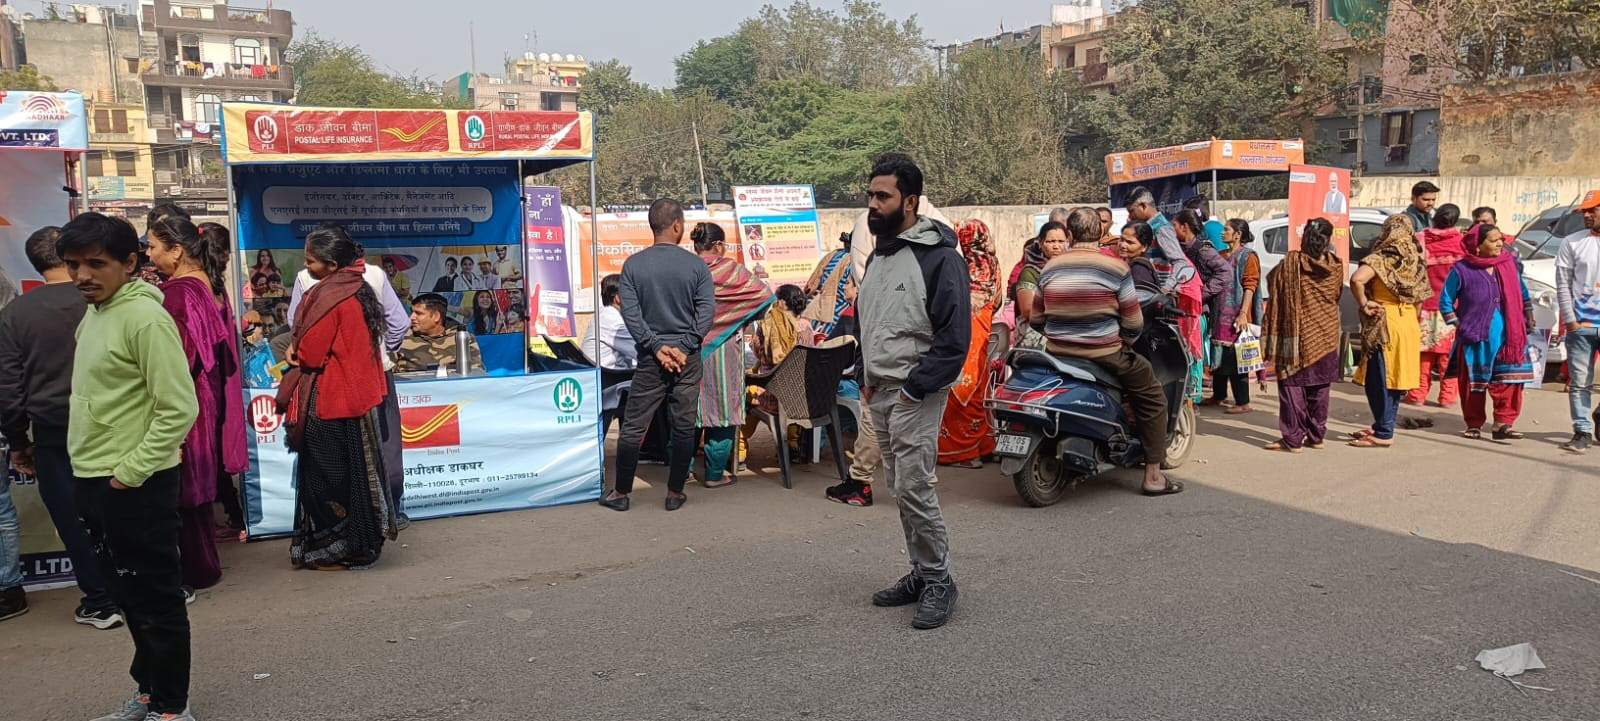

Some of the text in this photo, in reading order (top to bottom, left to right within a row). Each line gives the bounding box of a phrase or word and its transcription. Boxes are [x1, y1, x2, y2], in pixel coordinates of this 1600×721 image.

[293, 120, 372, 133] डाक जीवन बीमा
[294, 135, 373, 144] POSTAL LIFE INSURANCE
[432, 163, 453, 176] लिए
[457, 163, 470, 175] भी
[438, 191, 456, 201] आदि
[472, 203, 487, 214] लिए
[348, 221, 373, 232] जीवन
[376, 220, 395, 232] बीमा
[399, 221, 410, 232] का
[413, 394, 433, 405] डाक
[557, 414, 582, 424] RPLI
[257, 435, 276, 444] PLI
[446, 447, 461, 456] Post
[404, 461, 485, 477] अधीक्षक डाकघर
[35, 557, 74, 575] LTD
